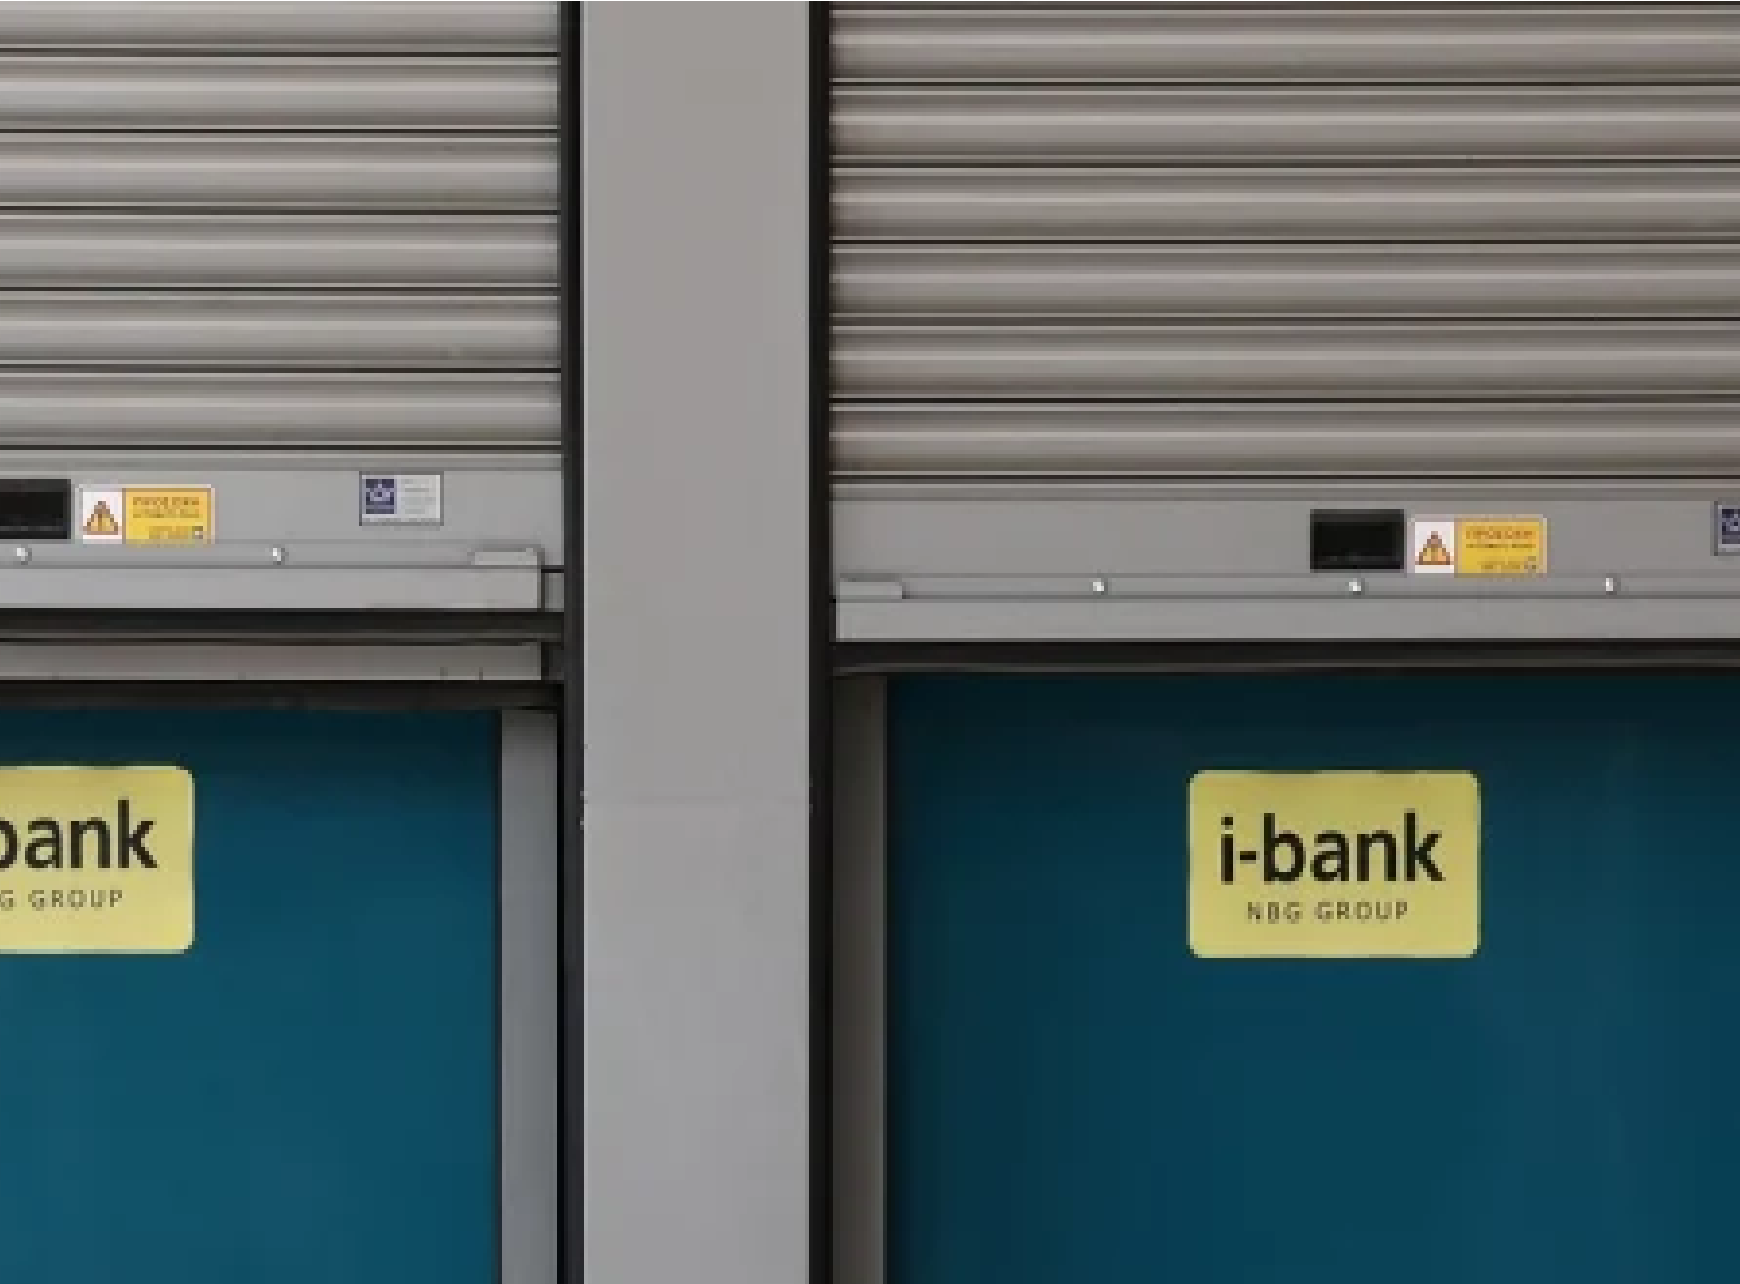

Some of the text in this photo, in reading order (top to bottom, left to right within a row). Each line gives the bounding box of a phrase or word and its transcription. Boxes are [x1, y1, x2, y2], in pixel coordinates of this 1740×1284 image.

[1220, 809, 1447, 885] i-bank
[27, 888, 124, 911] GROUP
[1246, 901, 1408, 924] NBG GROUP
